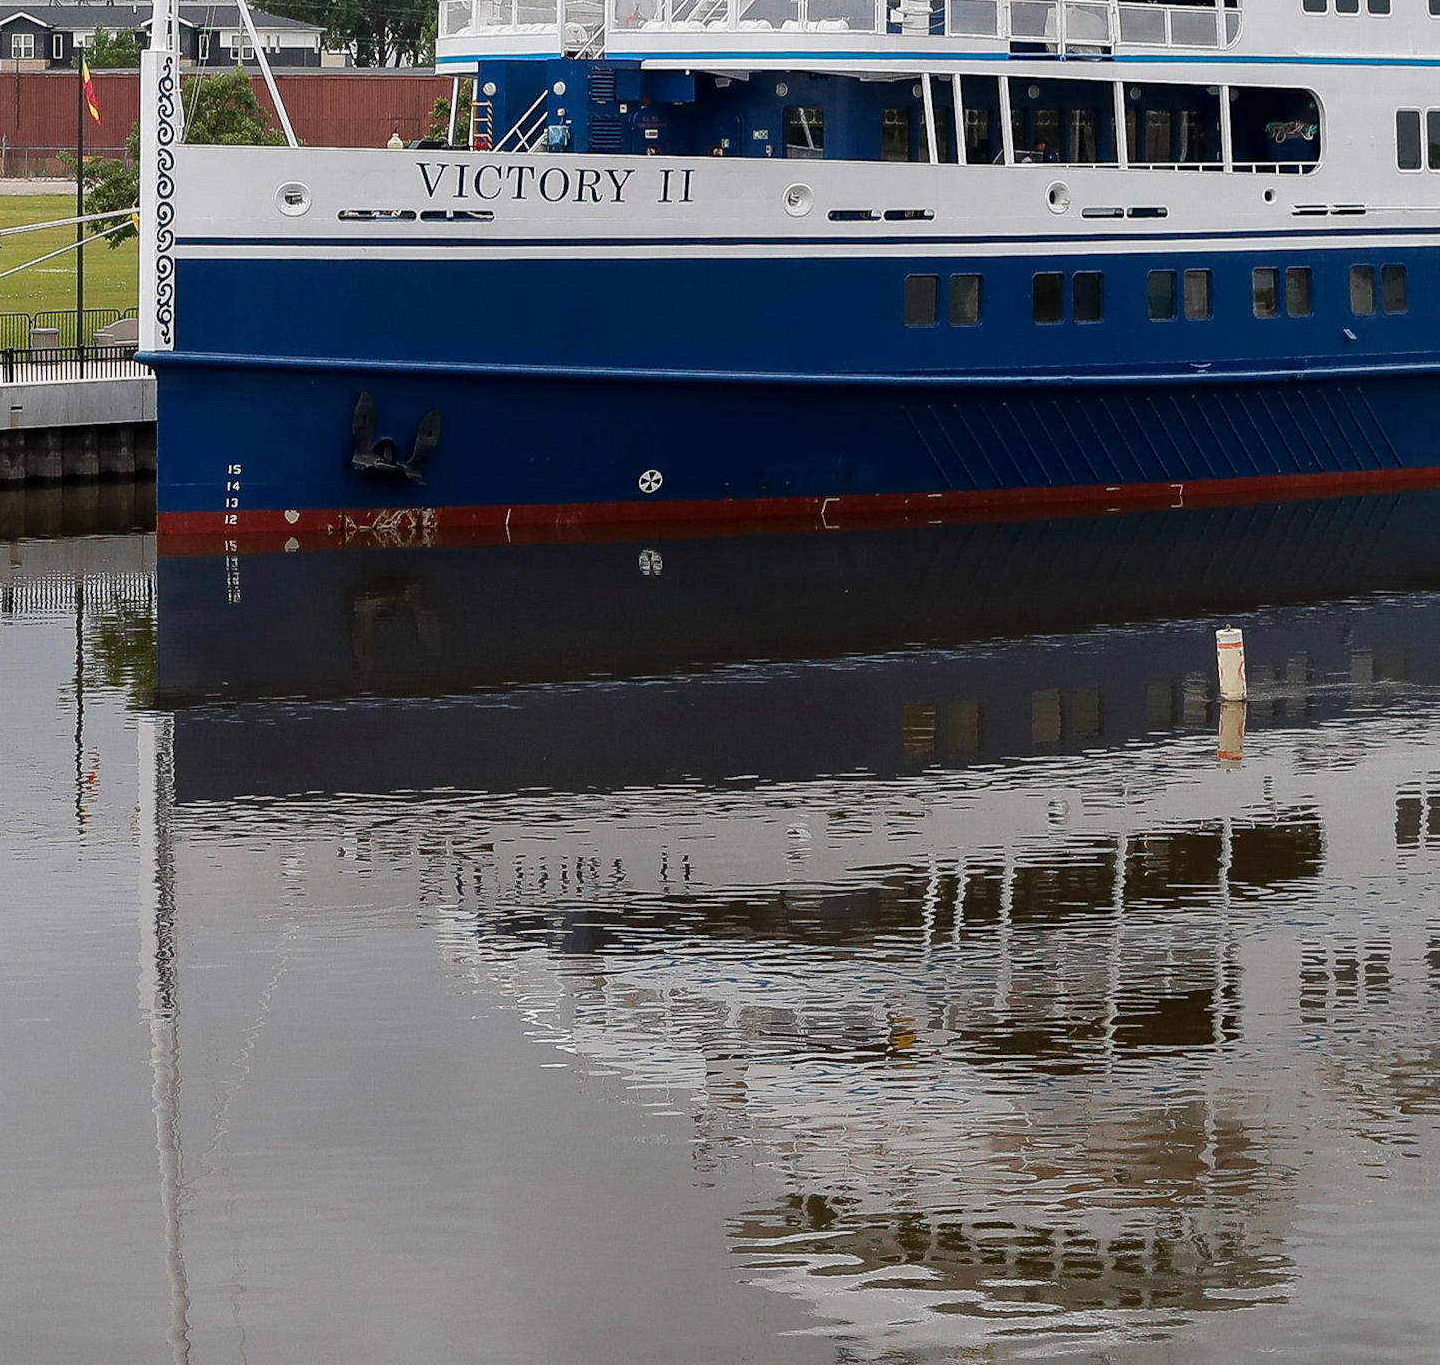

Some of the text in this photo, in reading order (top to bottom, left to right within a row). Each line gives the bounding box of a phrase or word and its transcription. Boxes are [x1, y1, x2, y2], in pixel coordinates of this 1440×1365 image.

[416, 162, 696, 204] VICTORY II
[228, 464, 242, 475] 15
[226, 481, 240, 491] 14
[225, 498, 239, 508] 13
[224, 514, 238, 525] 12
